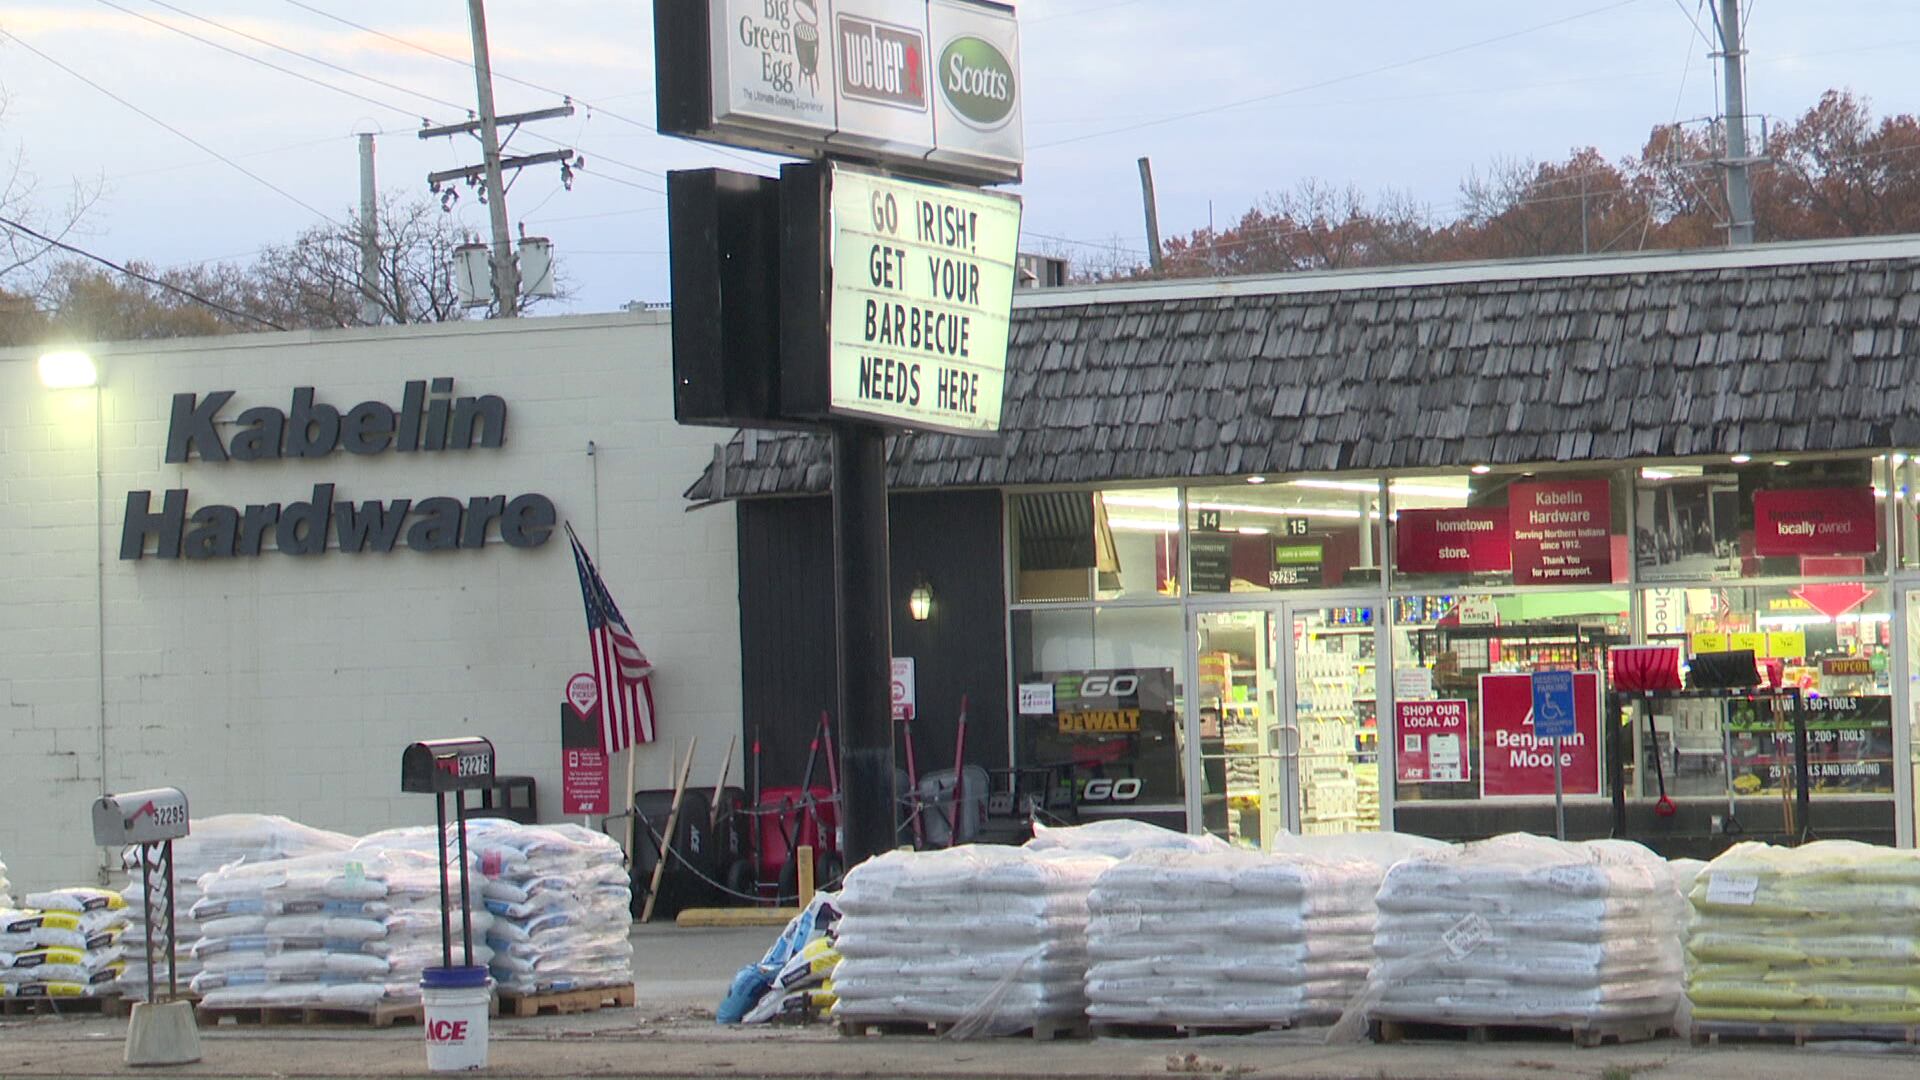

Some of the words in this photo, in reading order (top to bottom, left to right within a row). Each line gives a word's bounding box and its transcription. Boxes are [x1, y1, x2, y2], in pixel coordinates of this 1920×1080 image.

[764, 0, 790, 30] Big
[740, 15, 792, 54] Green
[844, 31, 904, 95] weber
[762, 51, 793, 93] Egg
[949, 53, 1007, 101] Scotts
[872, 189, 898, 234] GO
[915, 200, 978, 254] IRISH!
[870, 244, 905, 291] GET
[928, 255, 979, 305] YOUR
[865, 299, 970, 357] BARBECUE
[859, 356, 921, 406] NEEDS
[938, 366, 978, 414] HERE
[165, 377, 507, 464] Kabelin
[1535, 490, 1583, 505] Kabelin
[119, 483, 557, 560] Hardware
[1202, 512, 1217, 528] 14
[1529, 509, 1590, 524] Hardware
[1291, 520, 1306, 534] 15
[1436, 519, 1494, 532] hometown
[1777, 521, 1816, 537] locally
[1515, 530, 1544, 541] Serving
[1544, 529, 1576, 539] Northern
[1578, 527, 1606, 537] Indiana
[1438, 547, 1470, 559] store.
[1540, 541, 1560, 550] since
[1561, 540, 1581, 549] 1912.
[1543, 556, 1565, 565] Thank
[1567, 555, 1580, 564] You
[1270, 571, 1296, 583] 52295
[1532, 568, 1542, 577] for
[1543, 569, 1561, 578] your
[1562, 567, 1592, 577] support.
[1055, 675, 1138, 700] EGO
[1403, 705, 1433, 716] SHOP
[1436, 704, 1460, 715] OUR
[1404, 716, 1440, 728] LOCAL
[1443, 716, 1459, 727] AD
[1815, 731, 1837, 742] 200+
[1839, 729, 1866, 742] TOOLS
[460, 754, 489, 776] 52275
[1510, 750, 1572, 767] Mooe
[1404, 768, 1424, 779] ACE
[1821, 764, 1840, 776] AND
[1841, 763, 1880, 775] GROWING
[154, 805, 184, 826] 52295
[426, 1017, 468, 1041] ACE
